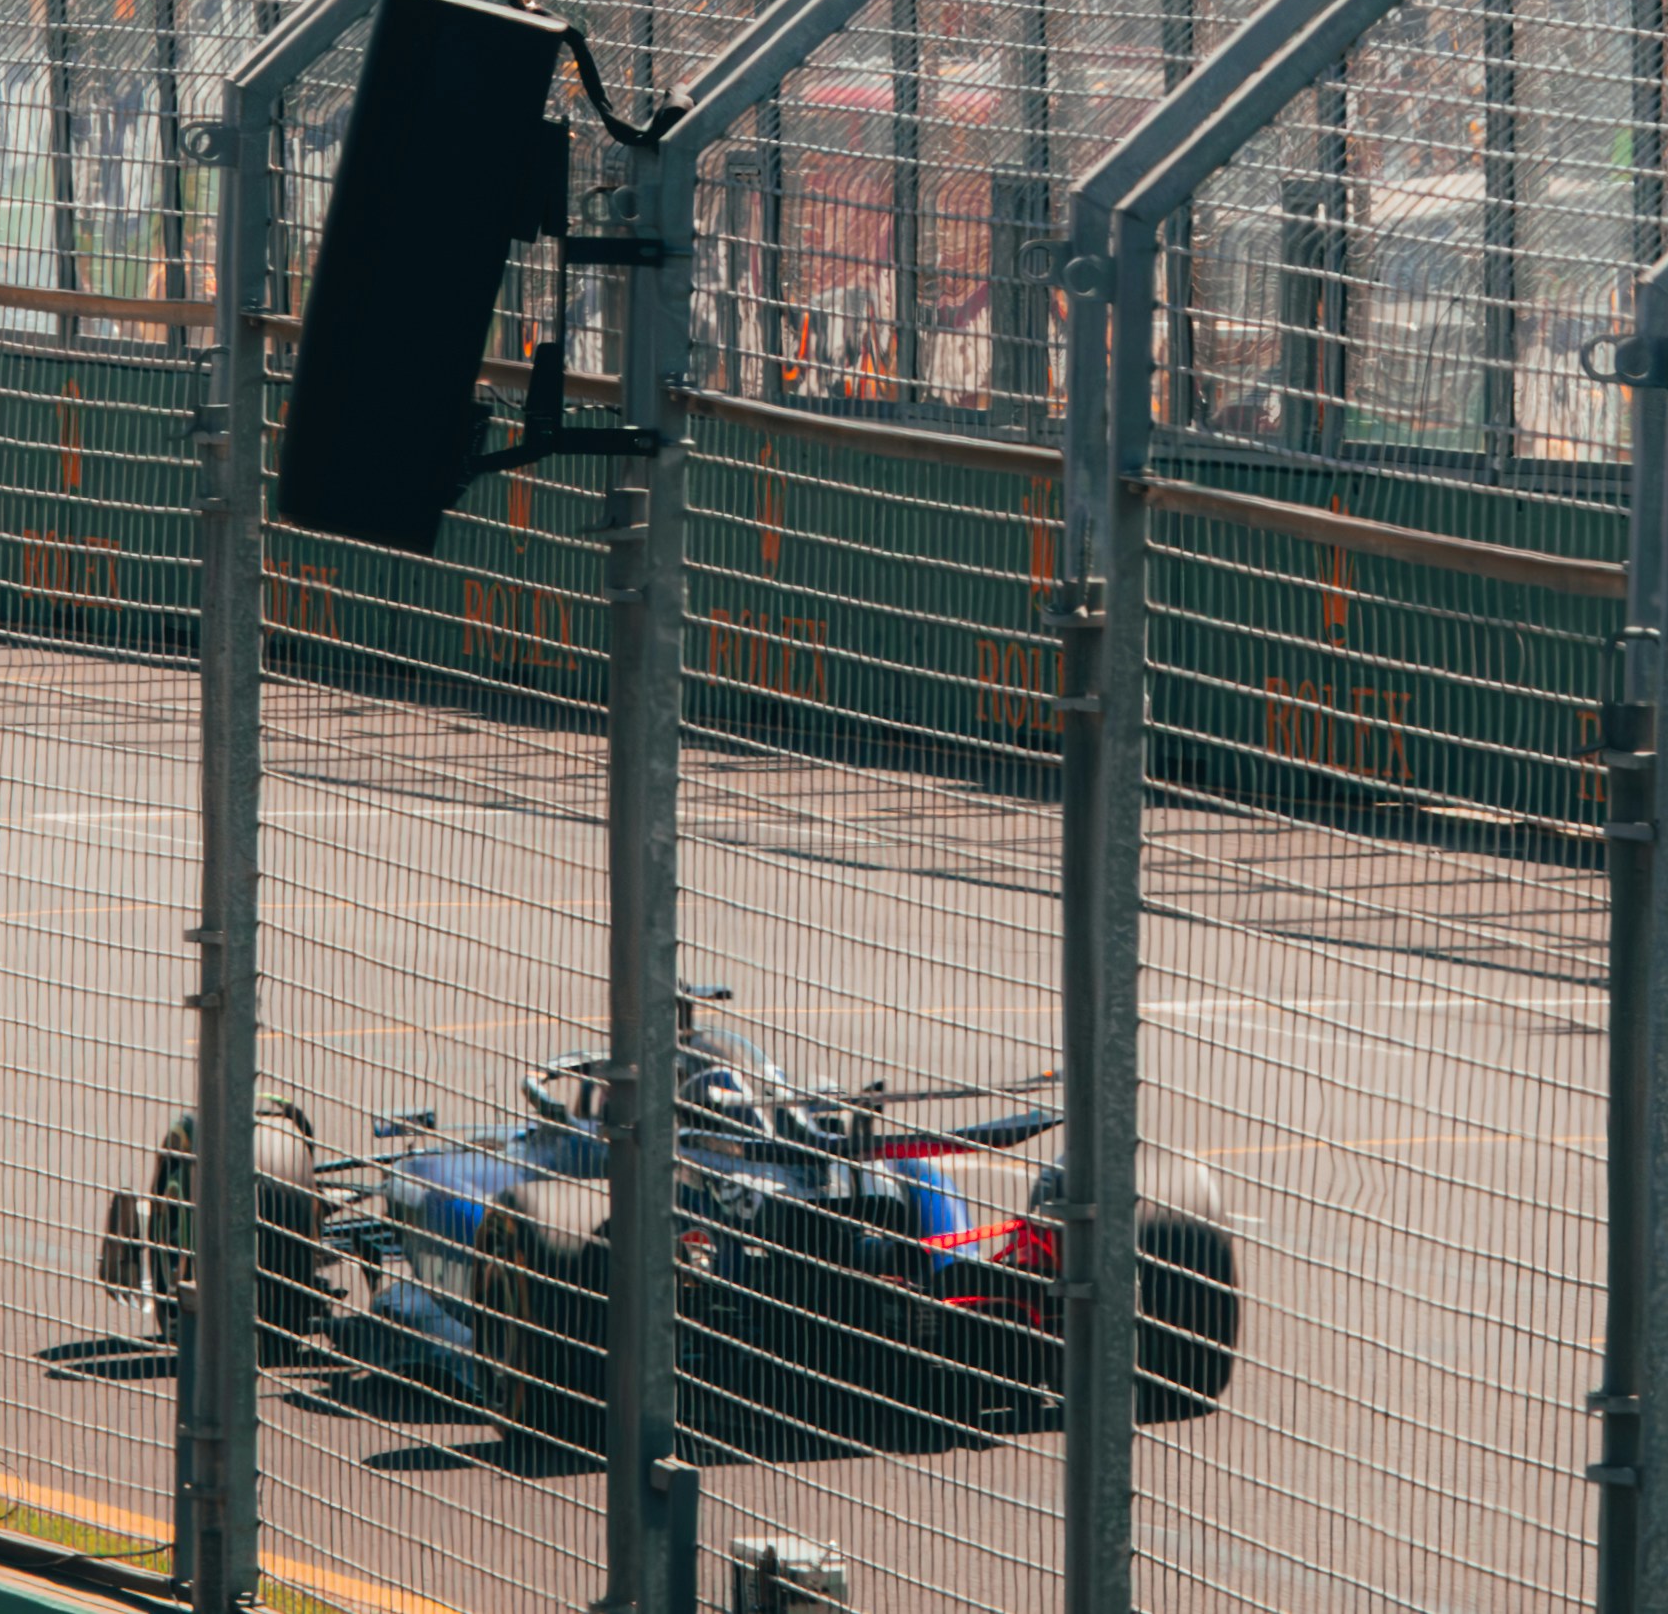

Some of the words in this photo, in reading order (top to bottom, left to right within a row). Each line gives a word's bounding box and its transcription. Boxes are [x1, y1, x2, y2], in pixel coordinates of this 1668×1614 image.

[22, 529, 122, 611] ROLEX
[263, 558, 342, 641] OLEX
[462, 578, 578, 671] ROLEX
[708, 608, 828, 703] ROLEX
[975, 639, 1064, 733] ROL
[1265, 676, 1413, 780] ROLEX
